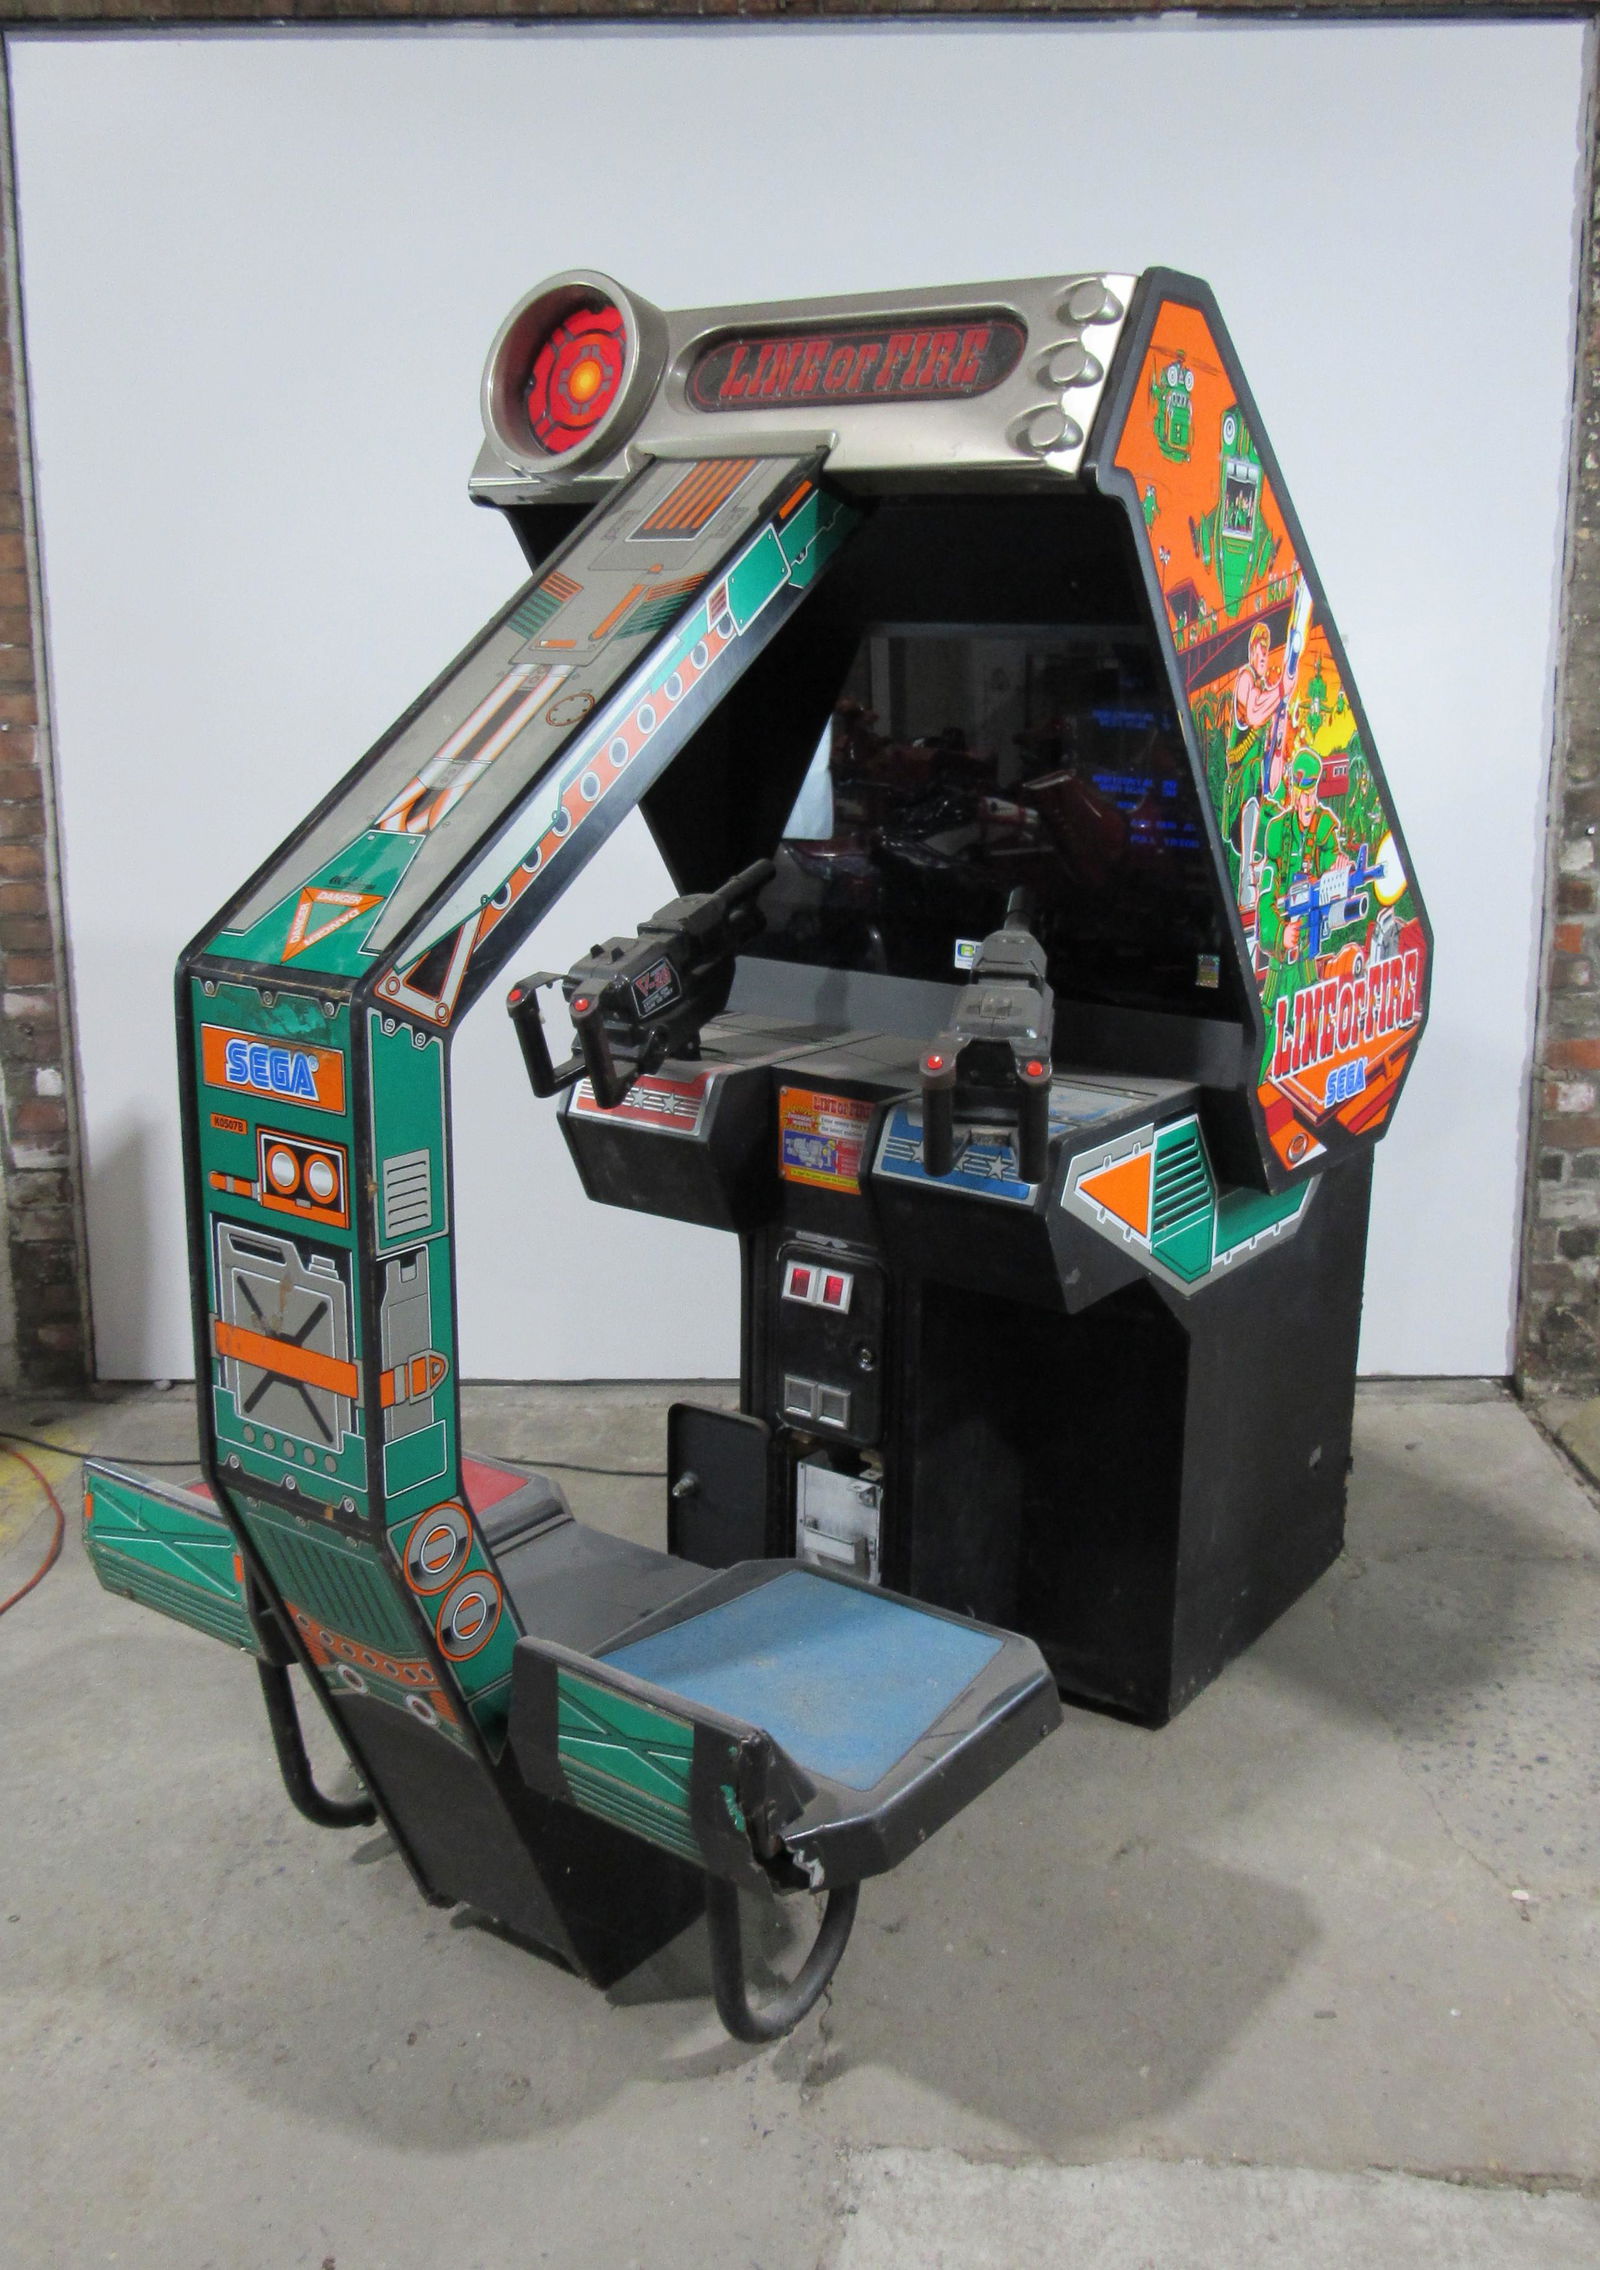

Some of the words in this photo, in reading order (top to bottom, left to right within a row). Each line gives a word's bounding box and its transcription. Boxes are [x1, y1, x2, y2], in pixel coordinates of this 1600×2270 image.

[719, 340, 831, 398] LINE
[822, 344, 882, 392] OF
[874, 328, 990, 389] FIRE
[314, 890, 363, 905] DANGER
[1272, 977, 1340, 1083] LINE
[1336, 978, 1368, 1053] OF
[1363, 949, 1418, 1043] FIRE
[225, 1038, 320, 1102] SEGA
[1325, 1057, 1368, 1108] SEGA
[813, 1095, 838, 1114] LINE
